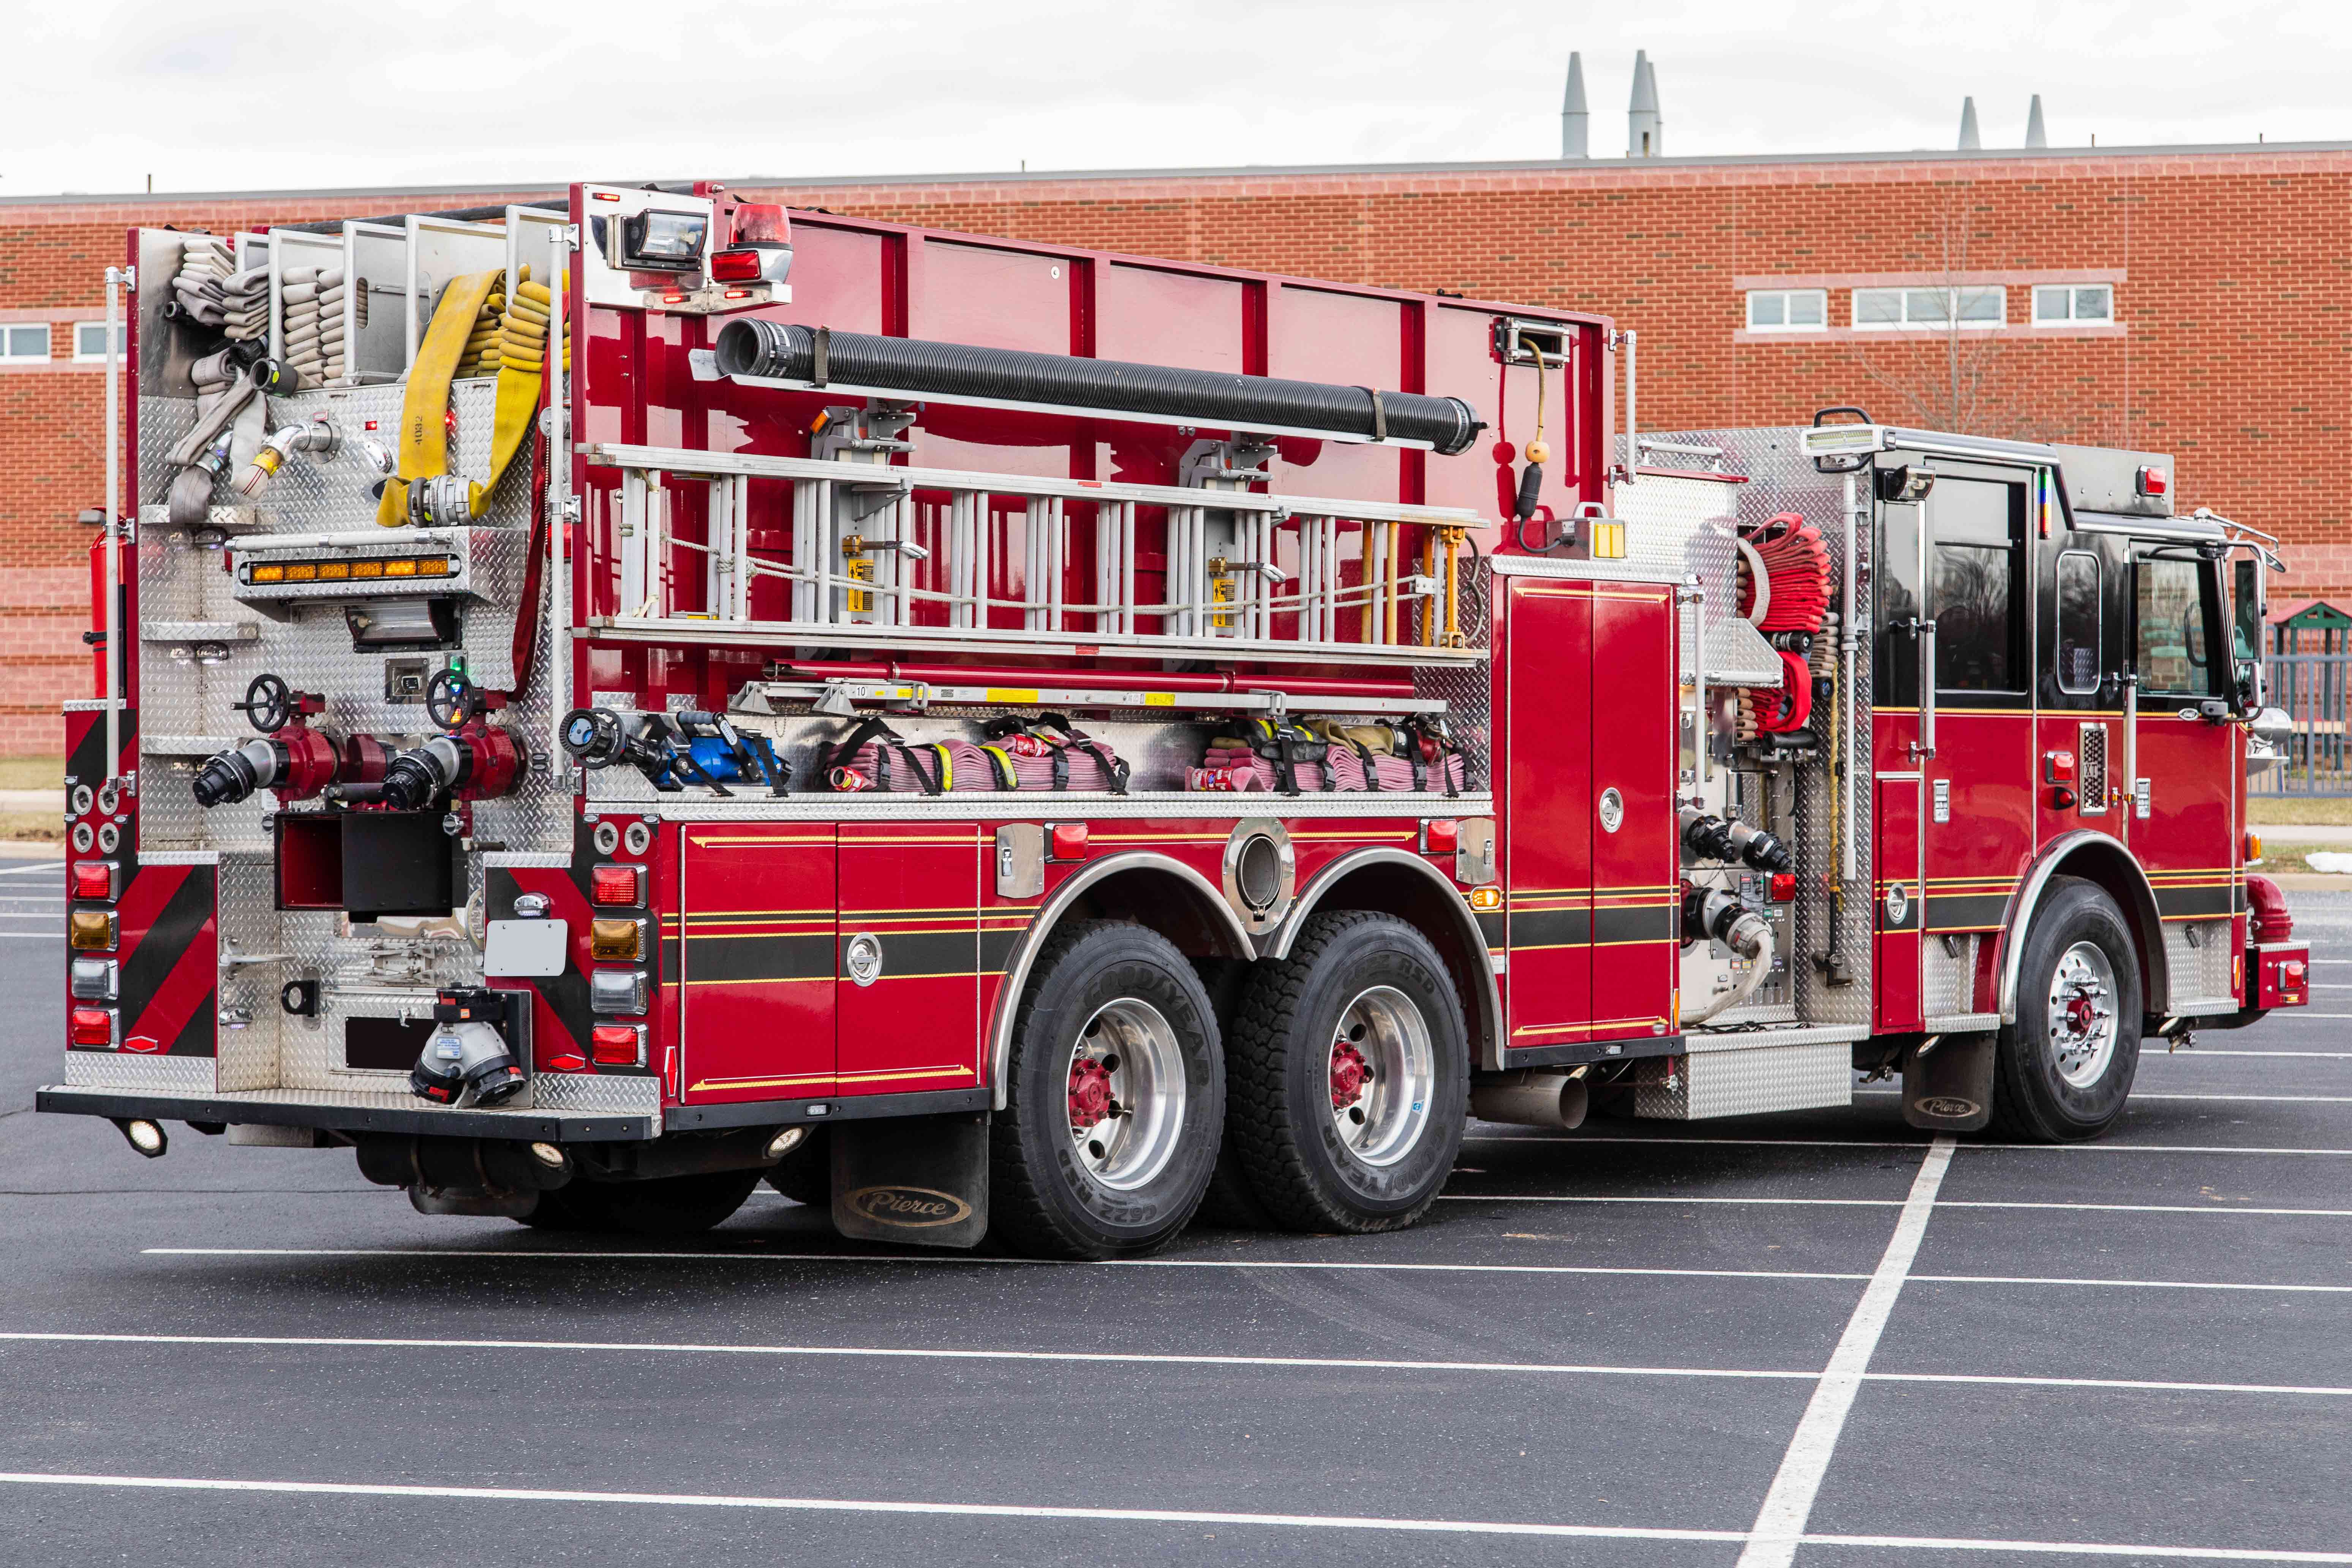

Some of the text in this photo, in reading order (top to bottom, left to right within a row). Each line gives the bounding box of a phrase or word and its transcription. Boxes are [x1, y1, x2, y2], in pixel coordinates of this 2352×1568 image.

[857, 686, 866, 696] 10
[2086, 764, 2097, 775] XT
[1083, 965, 1210, 1087] GOODYEAR
[1929, 1099, 1965, 1113] Pierce
[866, 1191, 948, 1216] Pierce
